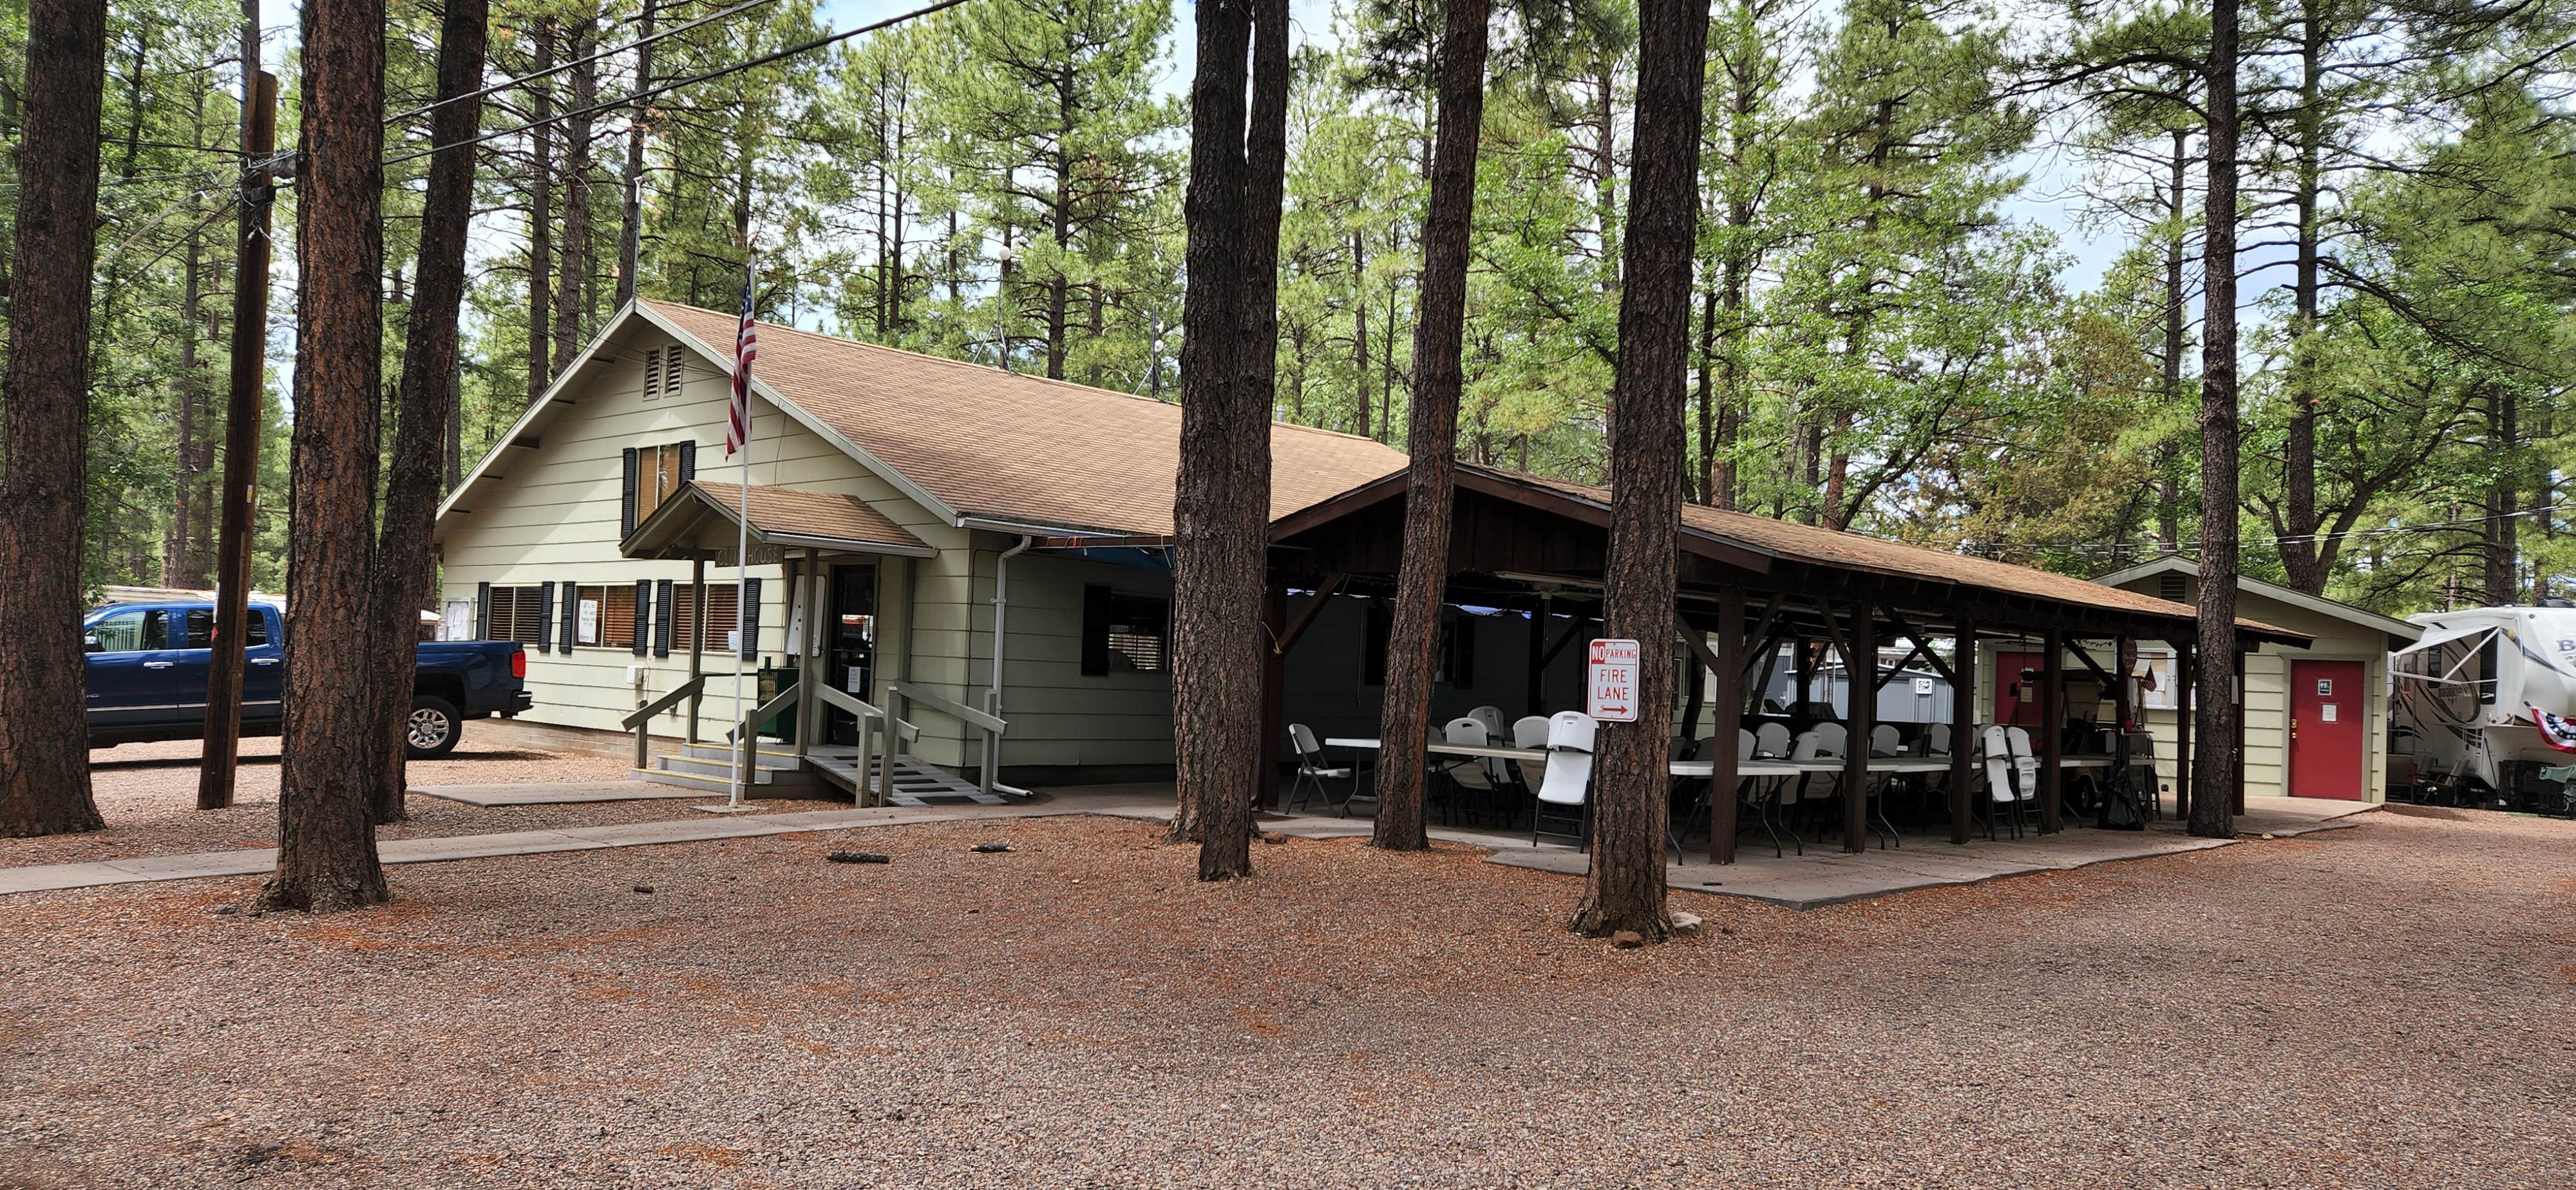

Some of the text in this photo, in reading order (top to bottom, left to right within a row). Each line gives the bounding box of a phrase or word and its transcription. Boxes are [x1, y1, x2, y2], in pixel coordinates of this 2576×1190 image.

[717, 547, 779, 566] CLU HOUSE
[1592, 645, 1636, 660] NO PARKING
[1600, 669, 1627, 683] FIRE
[1598, 686, 1629, 701] LANE
